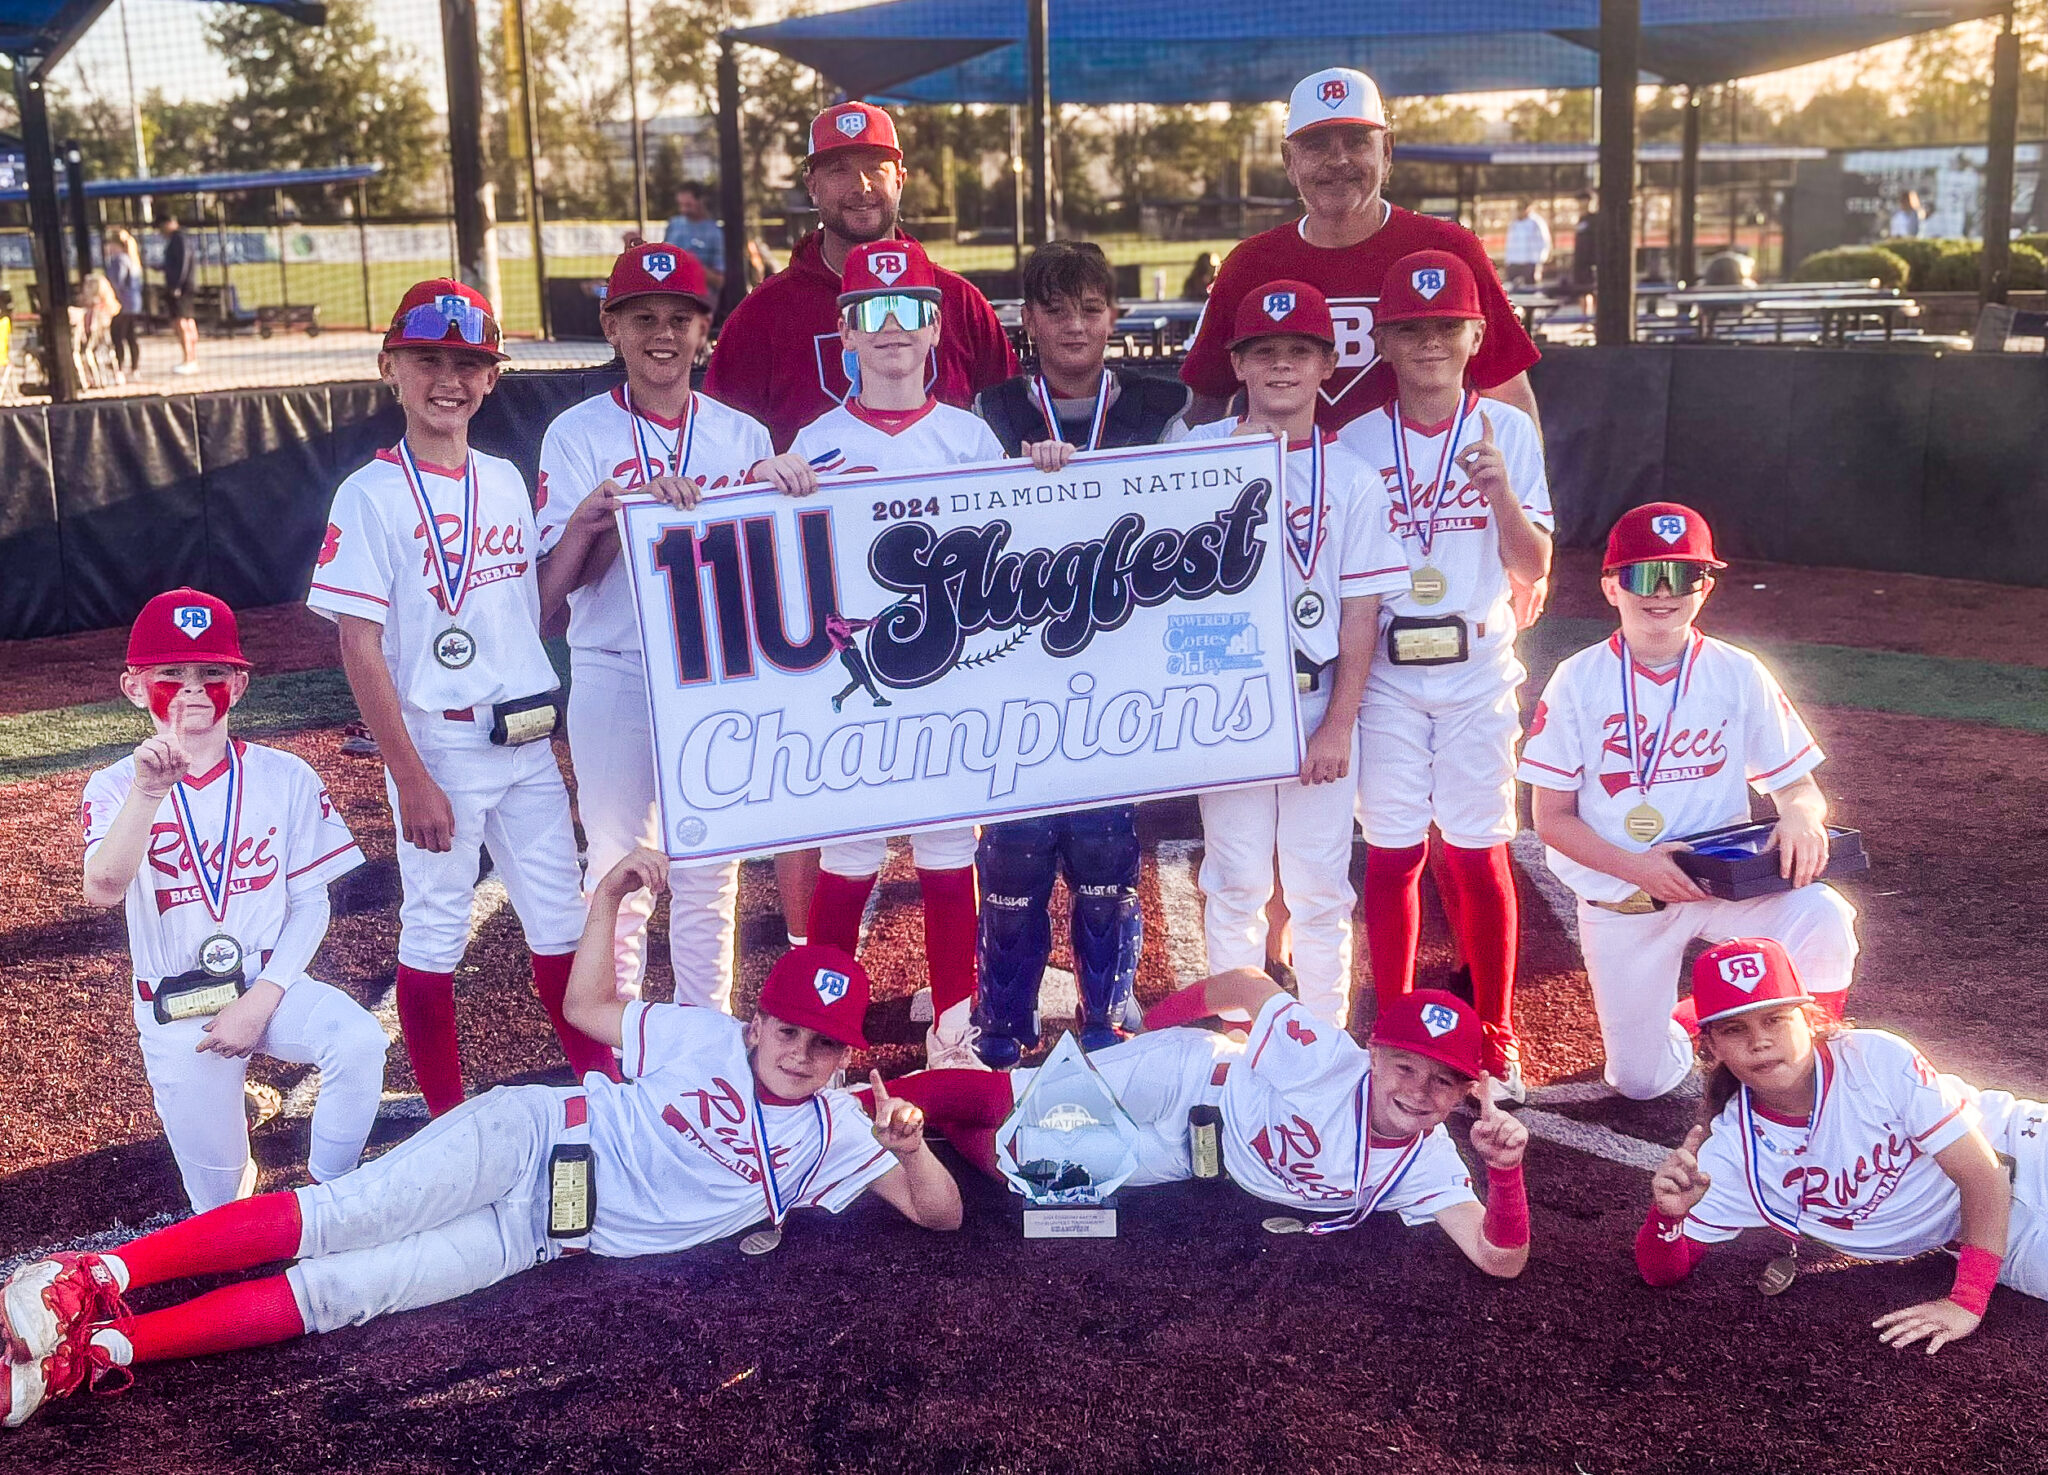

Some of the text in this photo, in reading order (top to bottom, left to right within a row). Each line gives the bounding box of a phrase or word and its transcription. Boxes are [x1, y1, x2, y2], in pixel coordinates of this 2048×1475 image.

[1322, 80, 1345, 101] RB
[648, 253, 671, 272] RB
[875, 255, 902, 274] RB
[1418, 270, 1440, 291] RB
[1267, 294, 1290, 313] RB
[1328, 306, 1375, 368] B
[872, 466, 1244, 521] 2024 DIAMOND NATION
[1659, 516, 1682, 535] RB
[865, 477, 1273, 690] Slugfest
[649, 505, 844, 689] 11U
[181, 607, 208, 628] RB
[678, 670, 1273, 811] Champions
[169, 879, 252, 903] BASALL
[1729, 957, 1760, 982] RB
[818, 971, 845, 997] RB
[1425, 1005, 1453, 1030] RB
